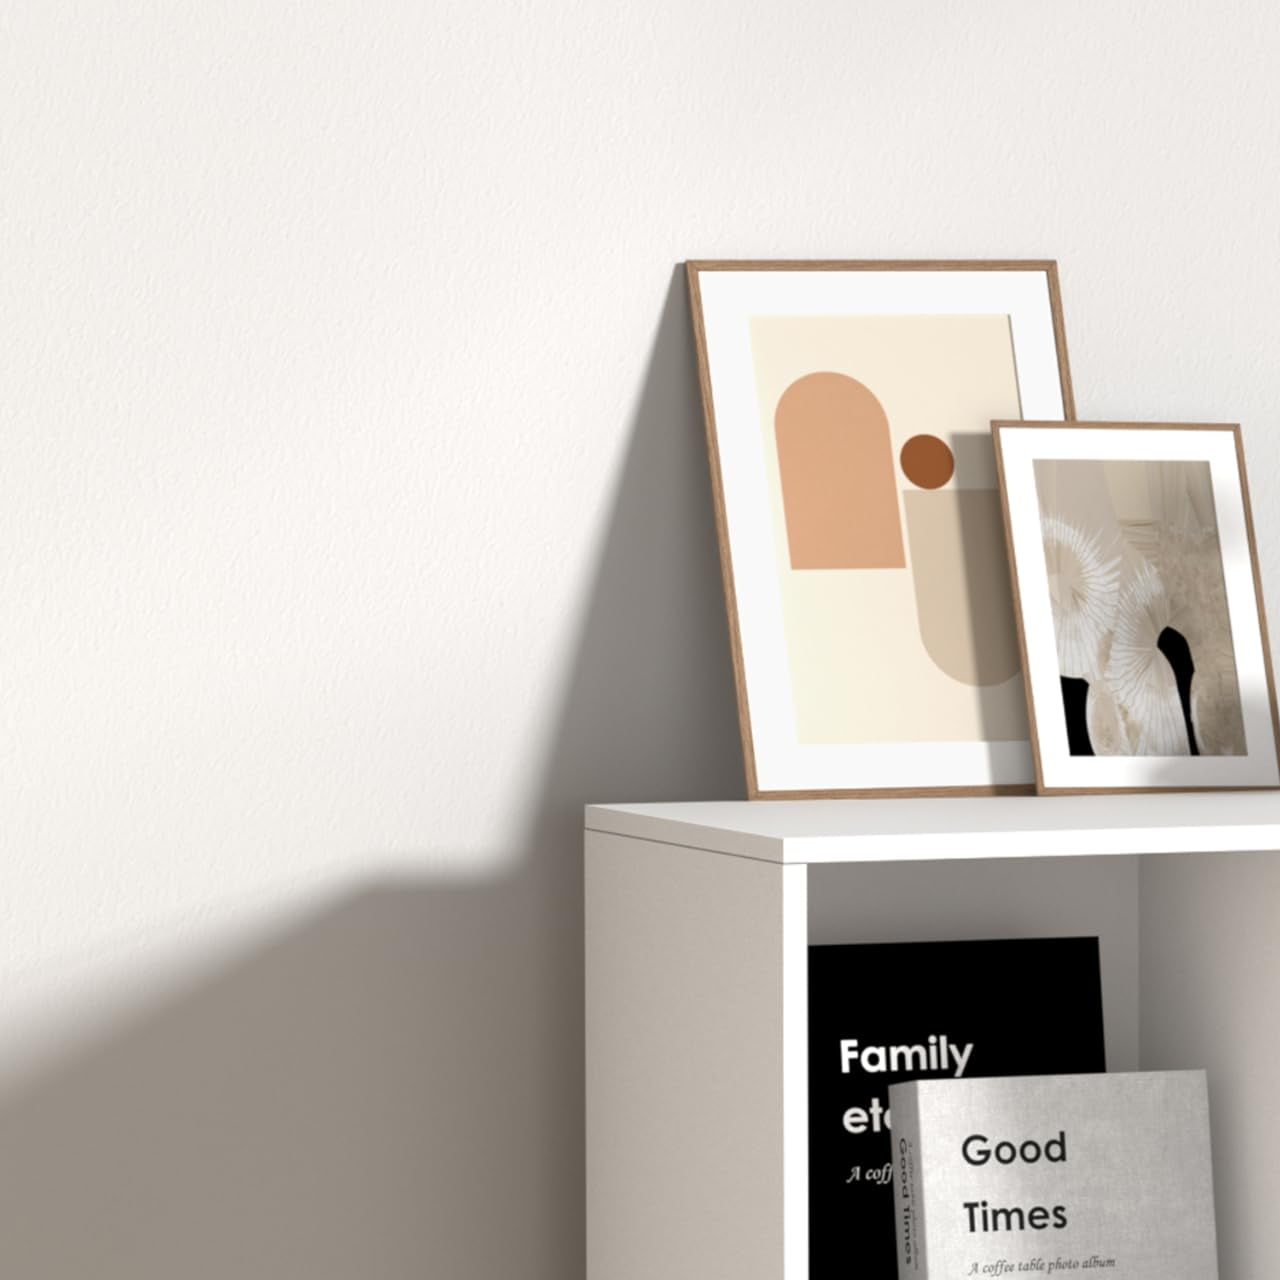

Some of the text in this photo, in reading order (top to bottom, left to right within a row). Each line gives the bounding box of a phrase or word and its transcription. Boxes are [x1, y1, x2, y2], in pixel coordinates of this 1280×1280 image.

[839, 1034, 974, 1078] Family
[962, 1131, 1067, 1166] Good
[845, 1162, 893, 1185] A coff
[899, 1138, 912, 1265] Good Times
[963, 1201, 1068, 1233] Times
[968, 1255, 1116, 1277] A coffee table photo album
